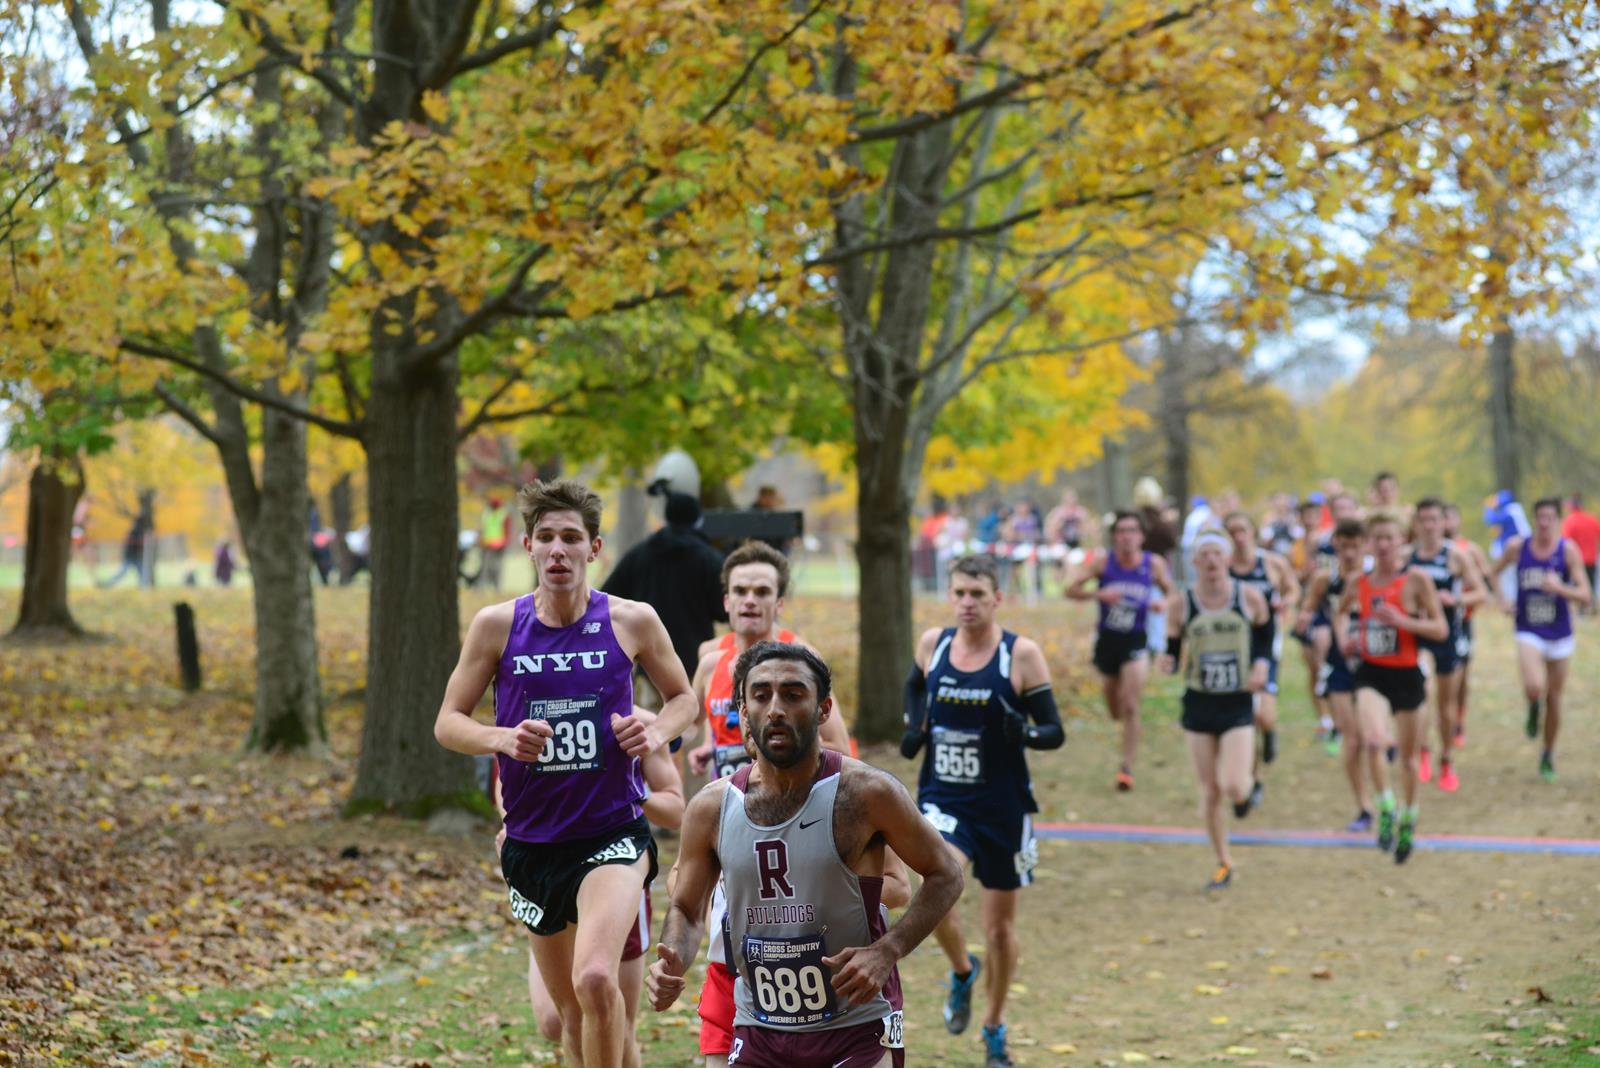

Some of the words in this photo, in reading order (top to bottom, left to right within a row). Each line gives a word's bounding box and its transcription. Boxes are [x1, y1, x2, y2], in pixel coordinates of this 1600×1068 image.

[512, 650, 608, 675] NYU
[937, 686, 992, 700] EMORY
[547, 702, 567, 710] CROSS
[568, 700, 597, 709] COUNTRY
[934, 743, 980, 777] 555
[754, 838, 796, 901] R
[745, 904, 815, 925] BULLDOGS
[763, 945, 786, 953] CROSS
[786, 941, 820, 953] COUNTRY
[754, 965, 827, 1014] 689
[767, 1015, 797, 1024] NOVEMBER
[807, 1013, 823, 1022] 2016
